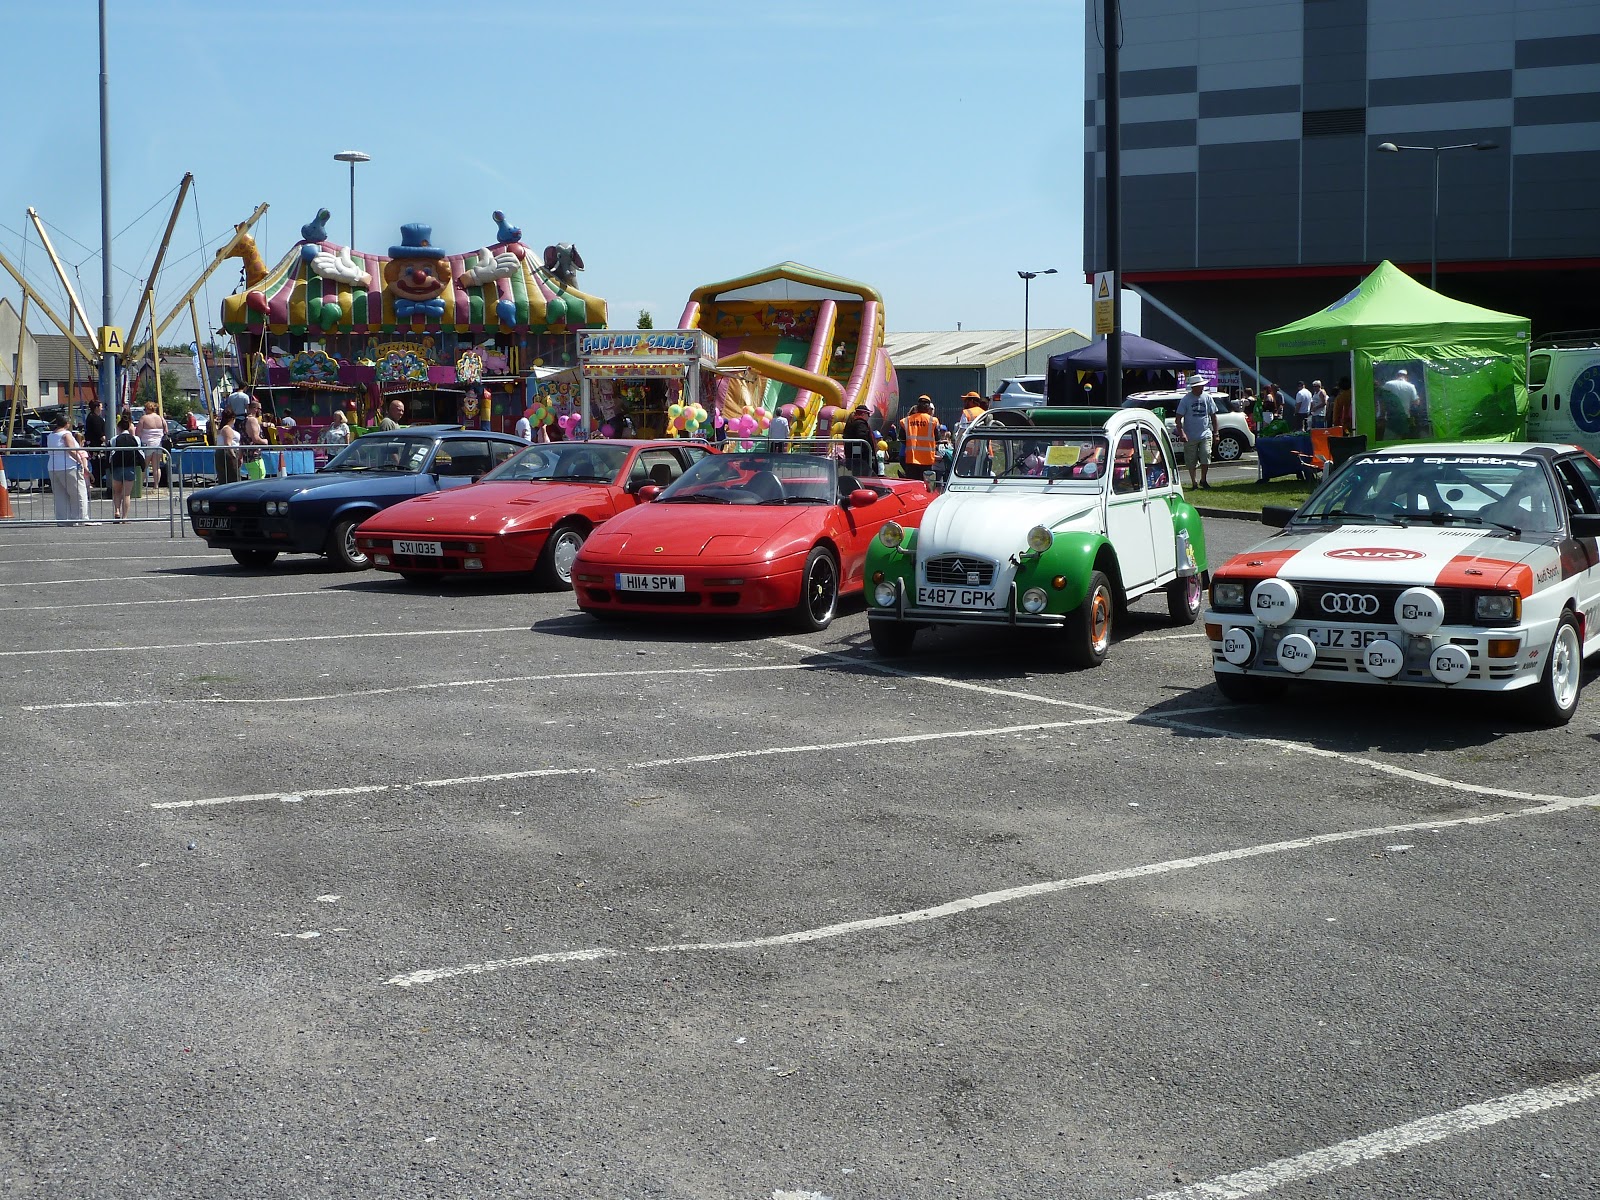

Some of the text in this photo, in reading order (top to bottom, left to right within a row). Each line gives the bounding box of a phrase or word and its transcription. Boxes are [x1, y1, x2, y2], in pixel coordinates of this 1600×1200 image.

[108, 330, 120, 348] A
[583, 337, 610, 351] FUN
[613, 335, 641, 349] AND
[646, 334, 694, 350] GAMES
[1355, 456, 1538, 468] Audi quattro
[198, 517, 228, 528] C767 JAX
[1332, 550, 1416, 559] Audi
[626, 575, 676, 590] H114 SPW
[1536, 565, 1560, 585] Audi Sport
[918, 587, 996, 607] E487 GPK
